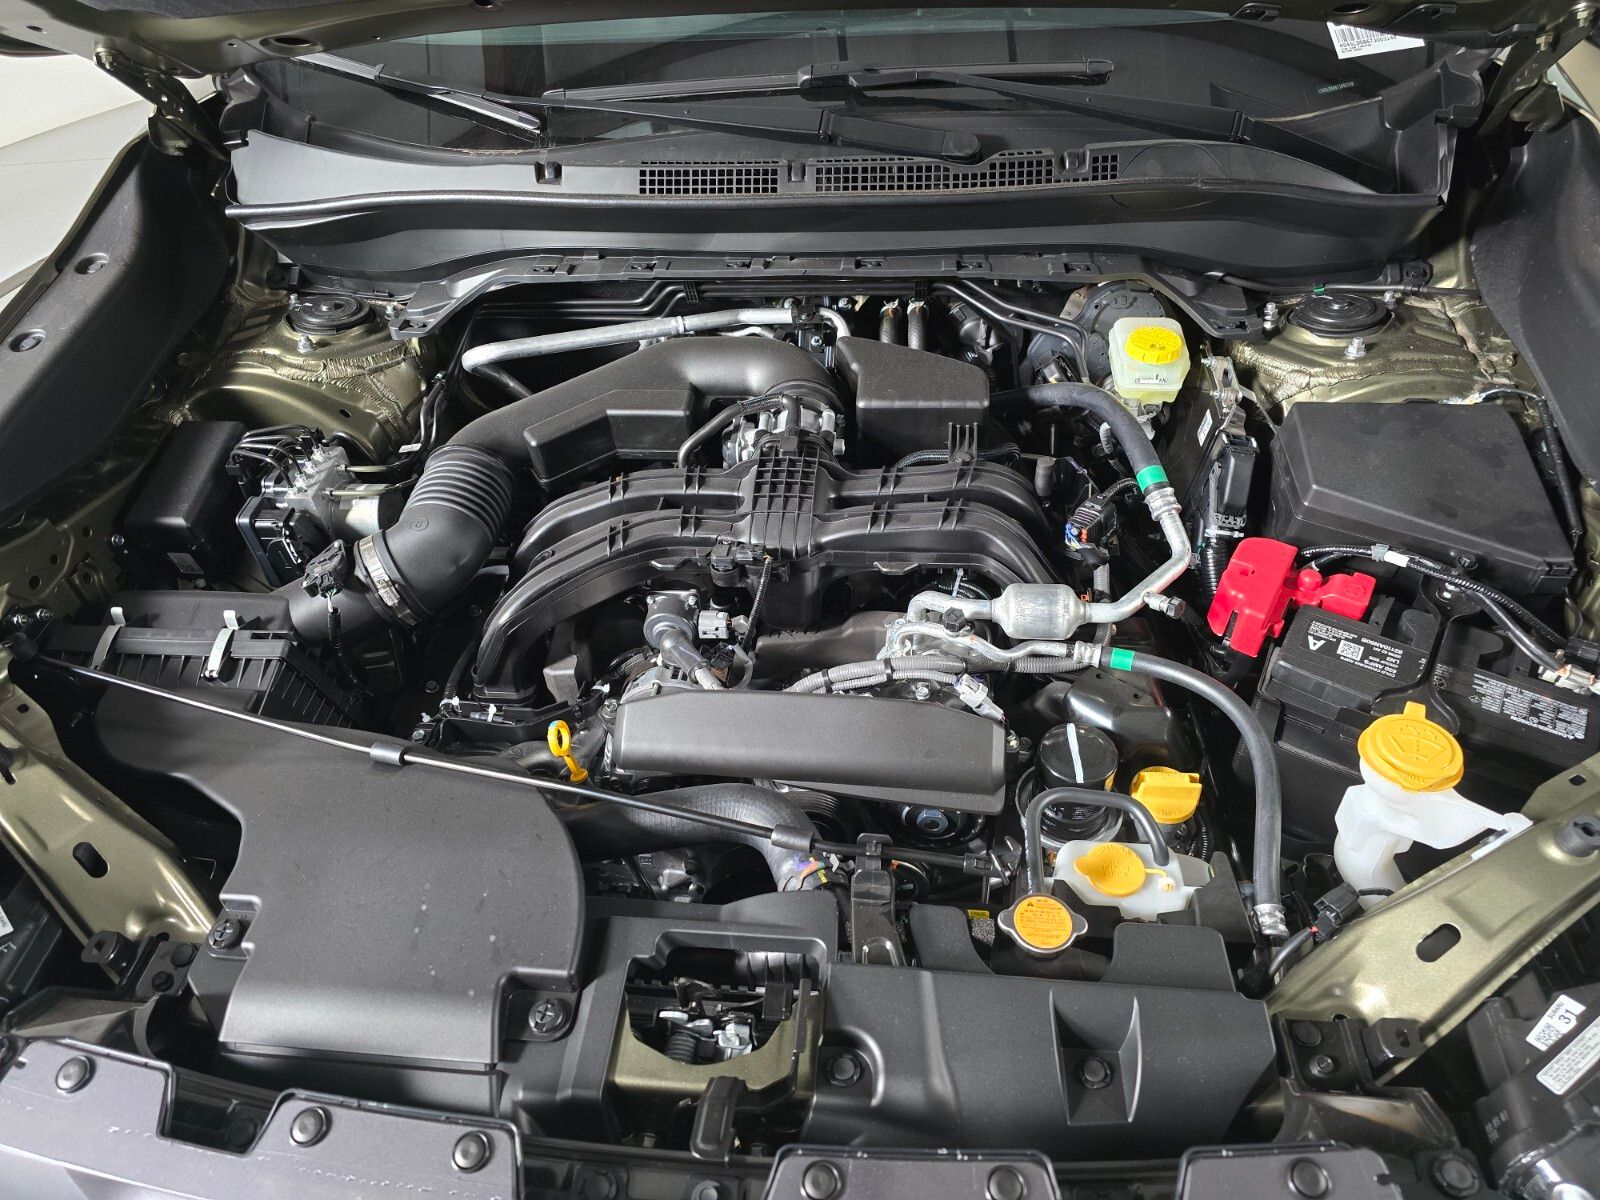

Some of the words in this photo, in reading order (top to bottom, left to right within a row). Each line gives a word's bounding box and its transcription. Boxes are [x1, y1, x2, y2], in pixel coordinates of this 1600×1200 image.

[1354, 661, 1381, 673] CRANKING
[1364, 660, 1384, 669] AMPS
[1558, 1009, 1576, 1024] 31
